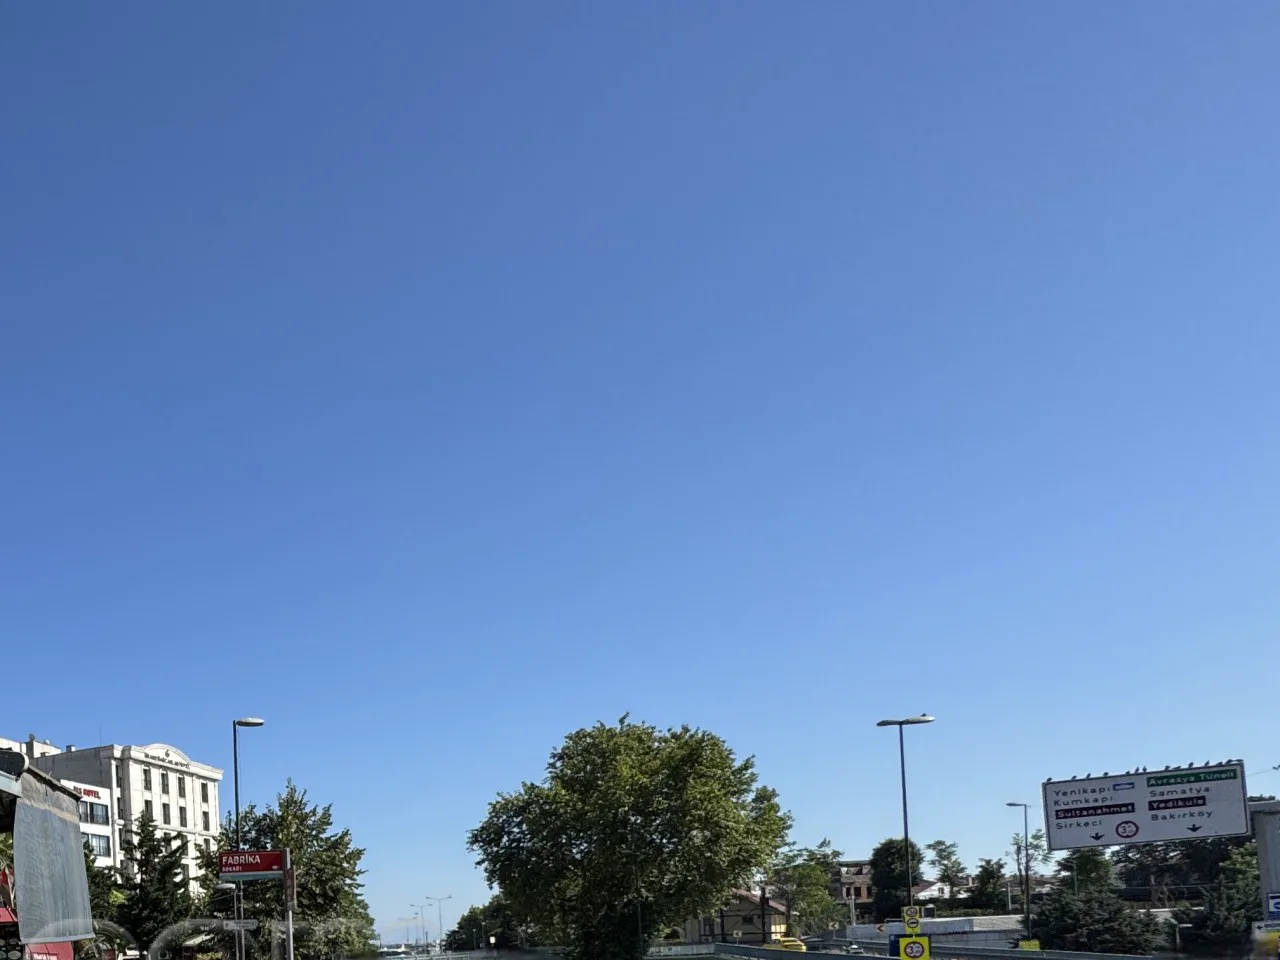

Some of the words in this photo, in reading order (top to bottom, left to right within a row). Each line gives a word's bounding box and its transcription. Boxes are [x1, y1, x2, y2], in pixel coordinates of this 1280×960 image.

[1149, 786, 1210, 797] Samatya
[1151, 799, 1204, 810] Yedikule
[1057, 805, 1132, 818] Sultanahmet
[222, 854, 261, 866] FABRİKA
